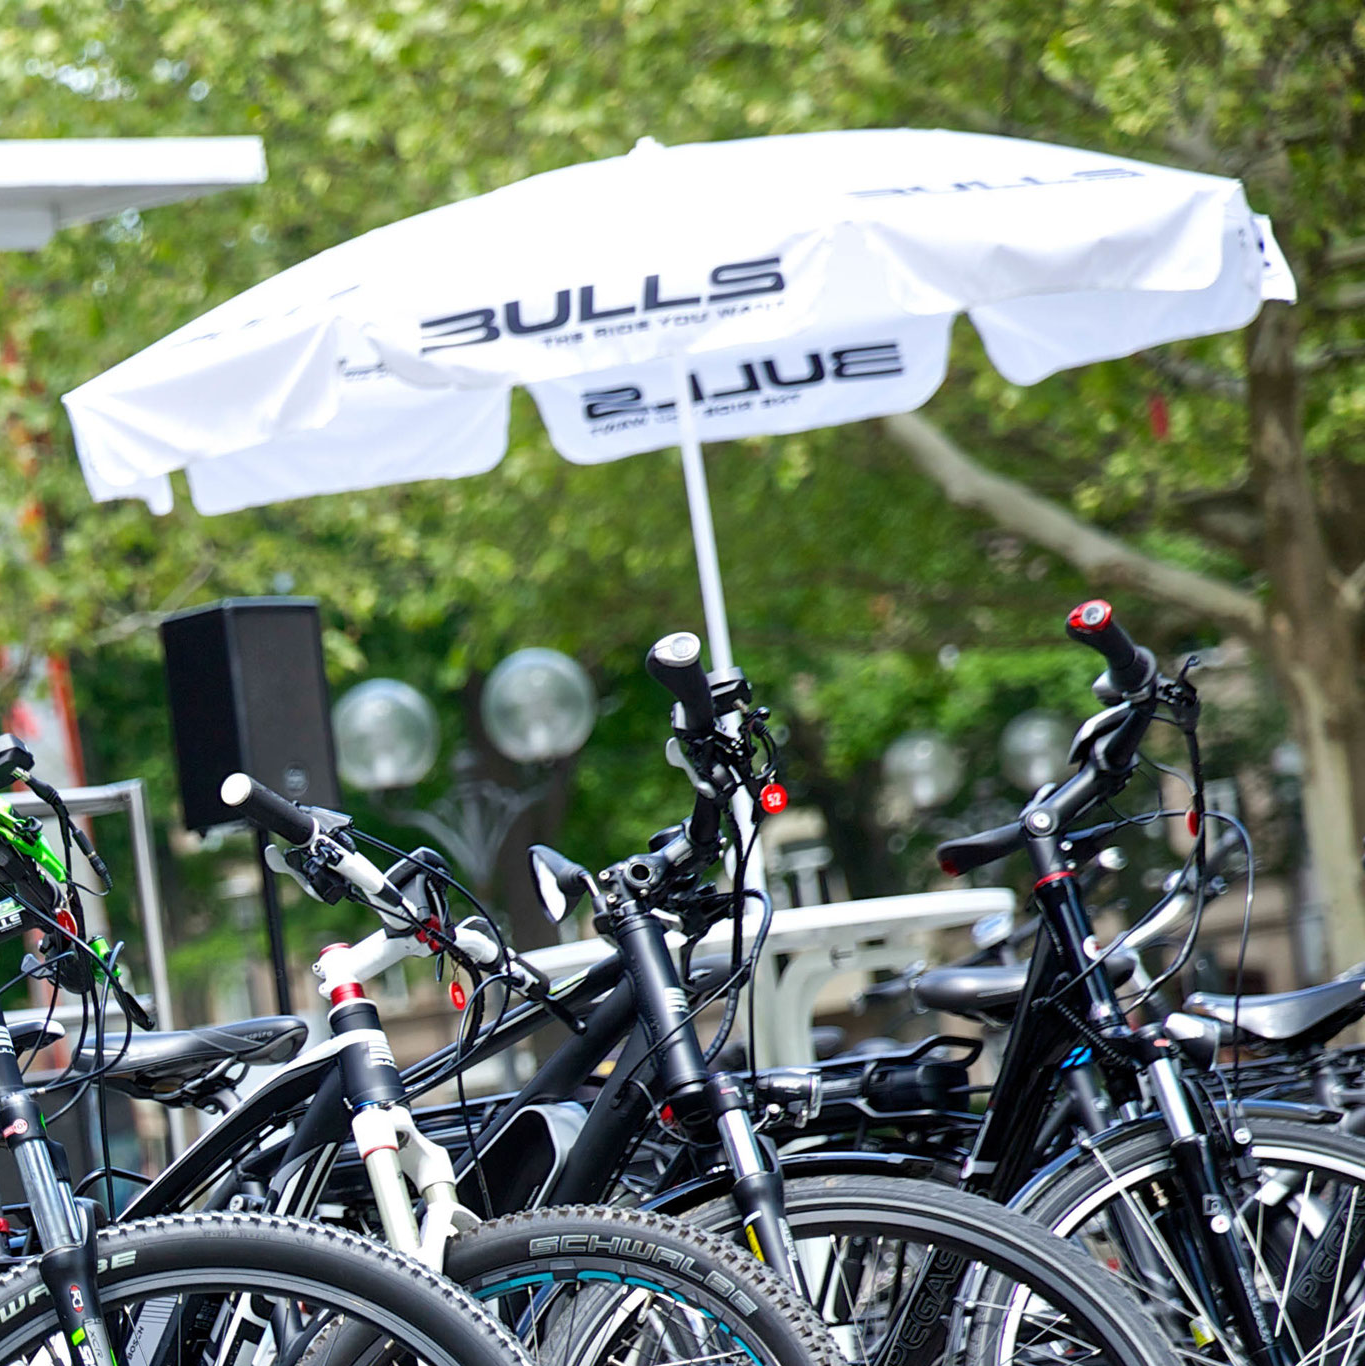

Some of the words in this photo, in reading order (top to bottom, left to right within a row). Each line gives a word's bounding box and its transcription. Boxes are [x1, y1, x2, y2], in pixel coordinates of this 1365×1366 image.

[420, 257, 786, 355] BULLS
[767, 792, 782, 807] 52
[529, 1234, 758, 1317] SCHWALBE
